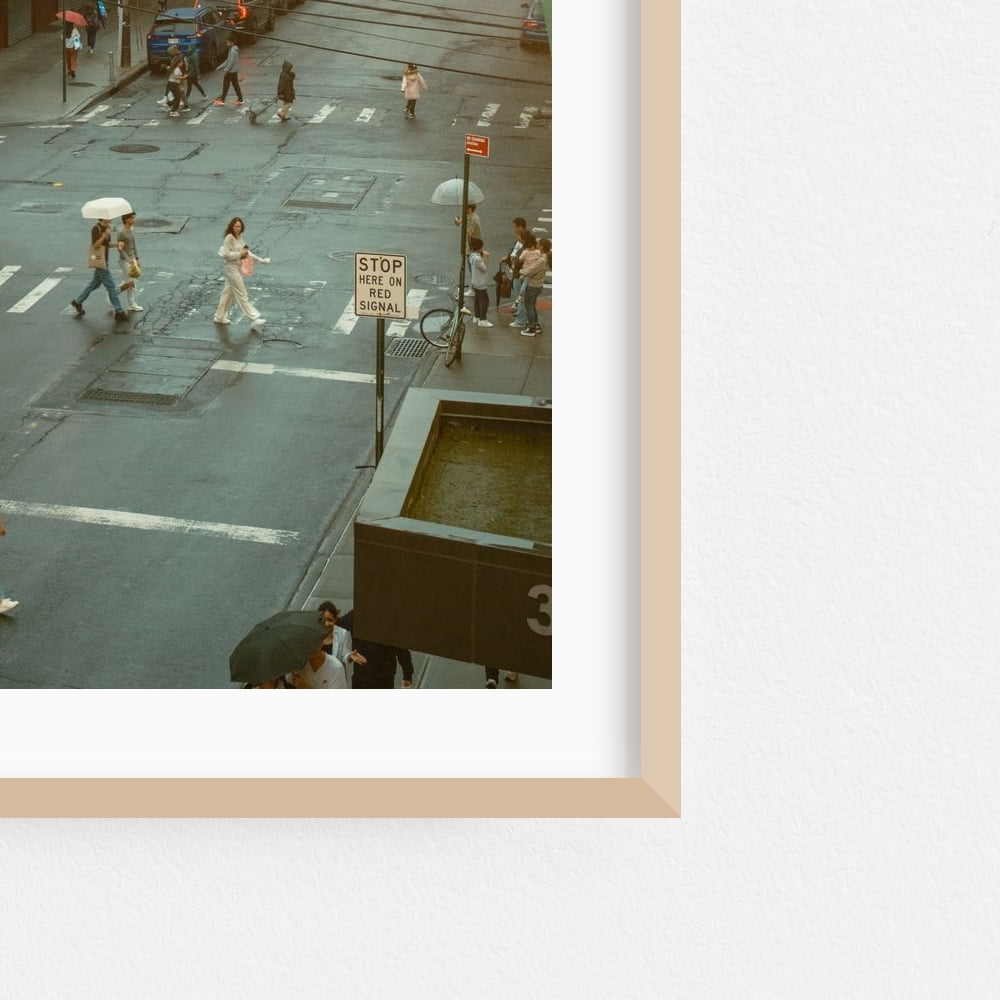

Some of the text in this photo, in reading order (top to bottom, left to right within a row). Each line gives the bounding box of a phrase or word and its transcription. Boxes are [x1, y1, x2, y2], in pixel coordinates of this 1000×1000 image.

[359, 257, 402, 273] STOP
[359, 275, 402, 287] HERE ON
[369, 288, 391, 299] RED
[360, 300, 401, 313] SIGNAL
